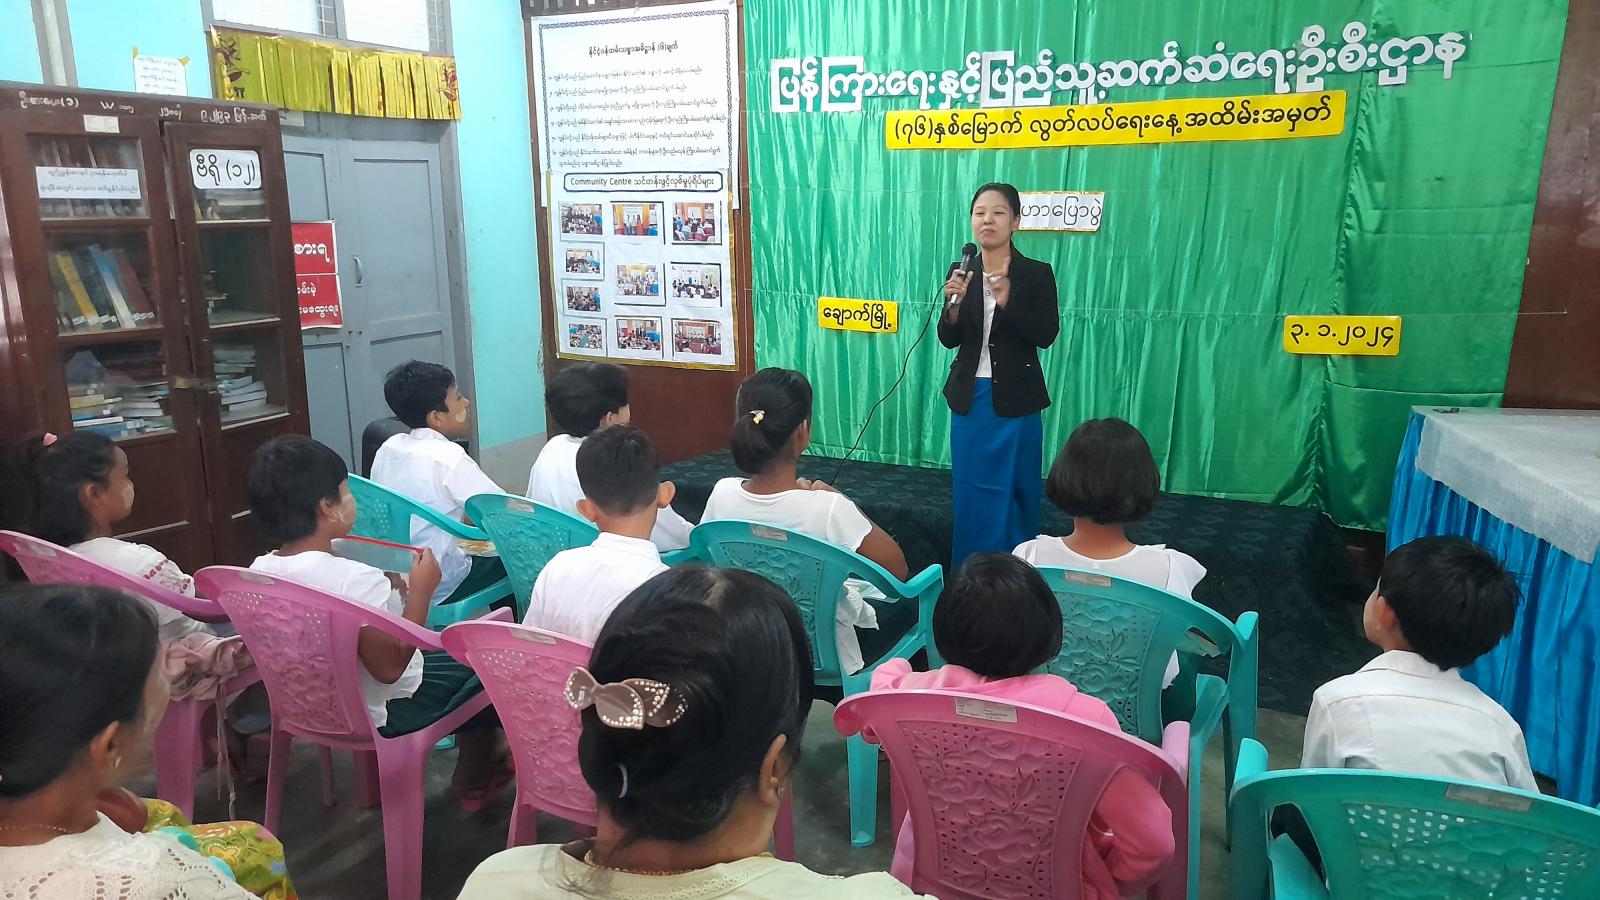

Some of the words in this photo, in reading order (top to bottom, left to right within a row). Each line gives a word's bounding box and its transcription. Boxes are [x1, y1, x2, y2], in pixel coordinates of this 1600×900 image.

[896, 112, 1022, 144] (၇၆)နှစ်မြောက်
[196, 154, 220, 187] ဗီရို
[225, 158, 256, 186] (၁၂)
[570, 176, 607, 187] Community
[609, 175, 632, 186] Centre
[822, 303, 893, 330] ချောက်မြို့
